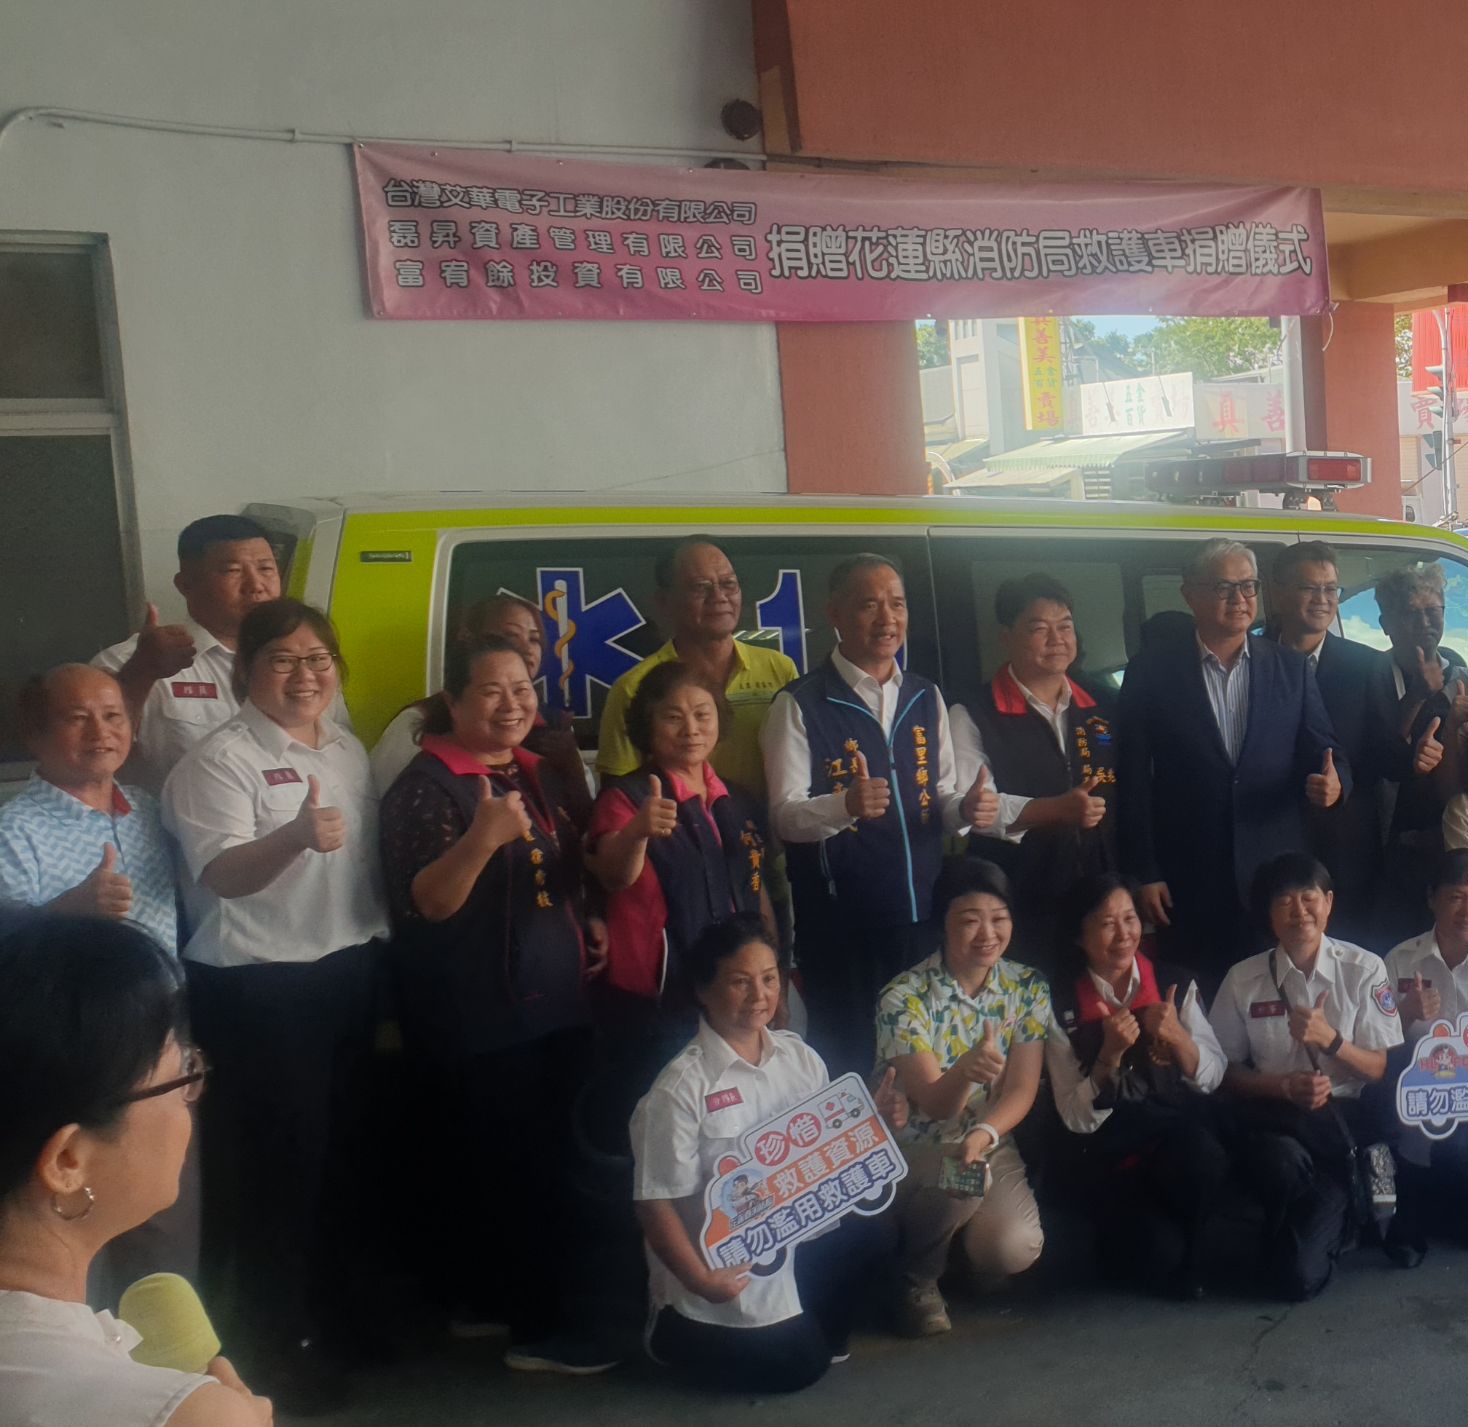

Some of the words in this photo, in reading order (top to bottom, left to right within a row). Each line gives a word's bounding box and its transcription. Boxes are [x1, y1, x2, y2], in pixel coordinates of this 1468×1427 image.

[383, 178, 757, 226] 台灣艾華電子工業股份有限公司
[387, 219, 757, 261] 磊昇資產管理有限公司
[766, 222, 1312, 281] 捐贈花蓮縣消防局救護車捐贈儀式
[393, 259, 764, 295] 富宥餘投資有限公司
[756, 1114, 820, 1165] 珍惜
[773, 1122, 879, 1198] 救護資源
[717, 1149, 896, 1267] 請勿濫用救護車
